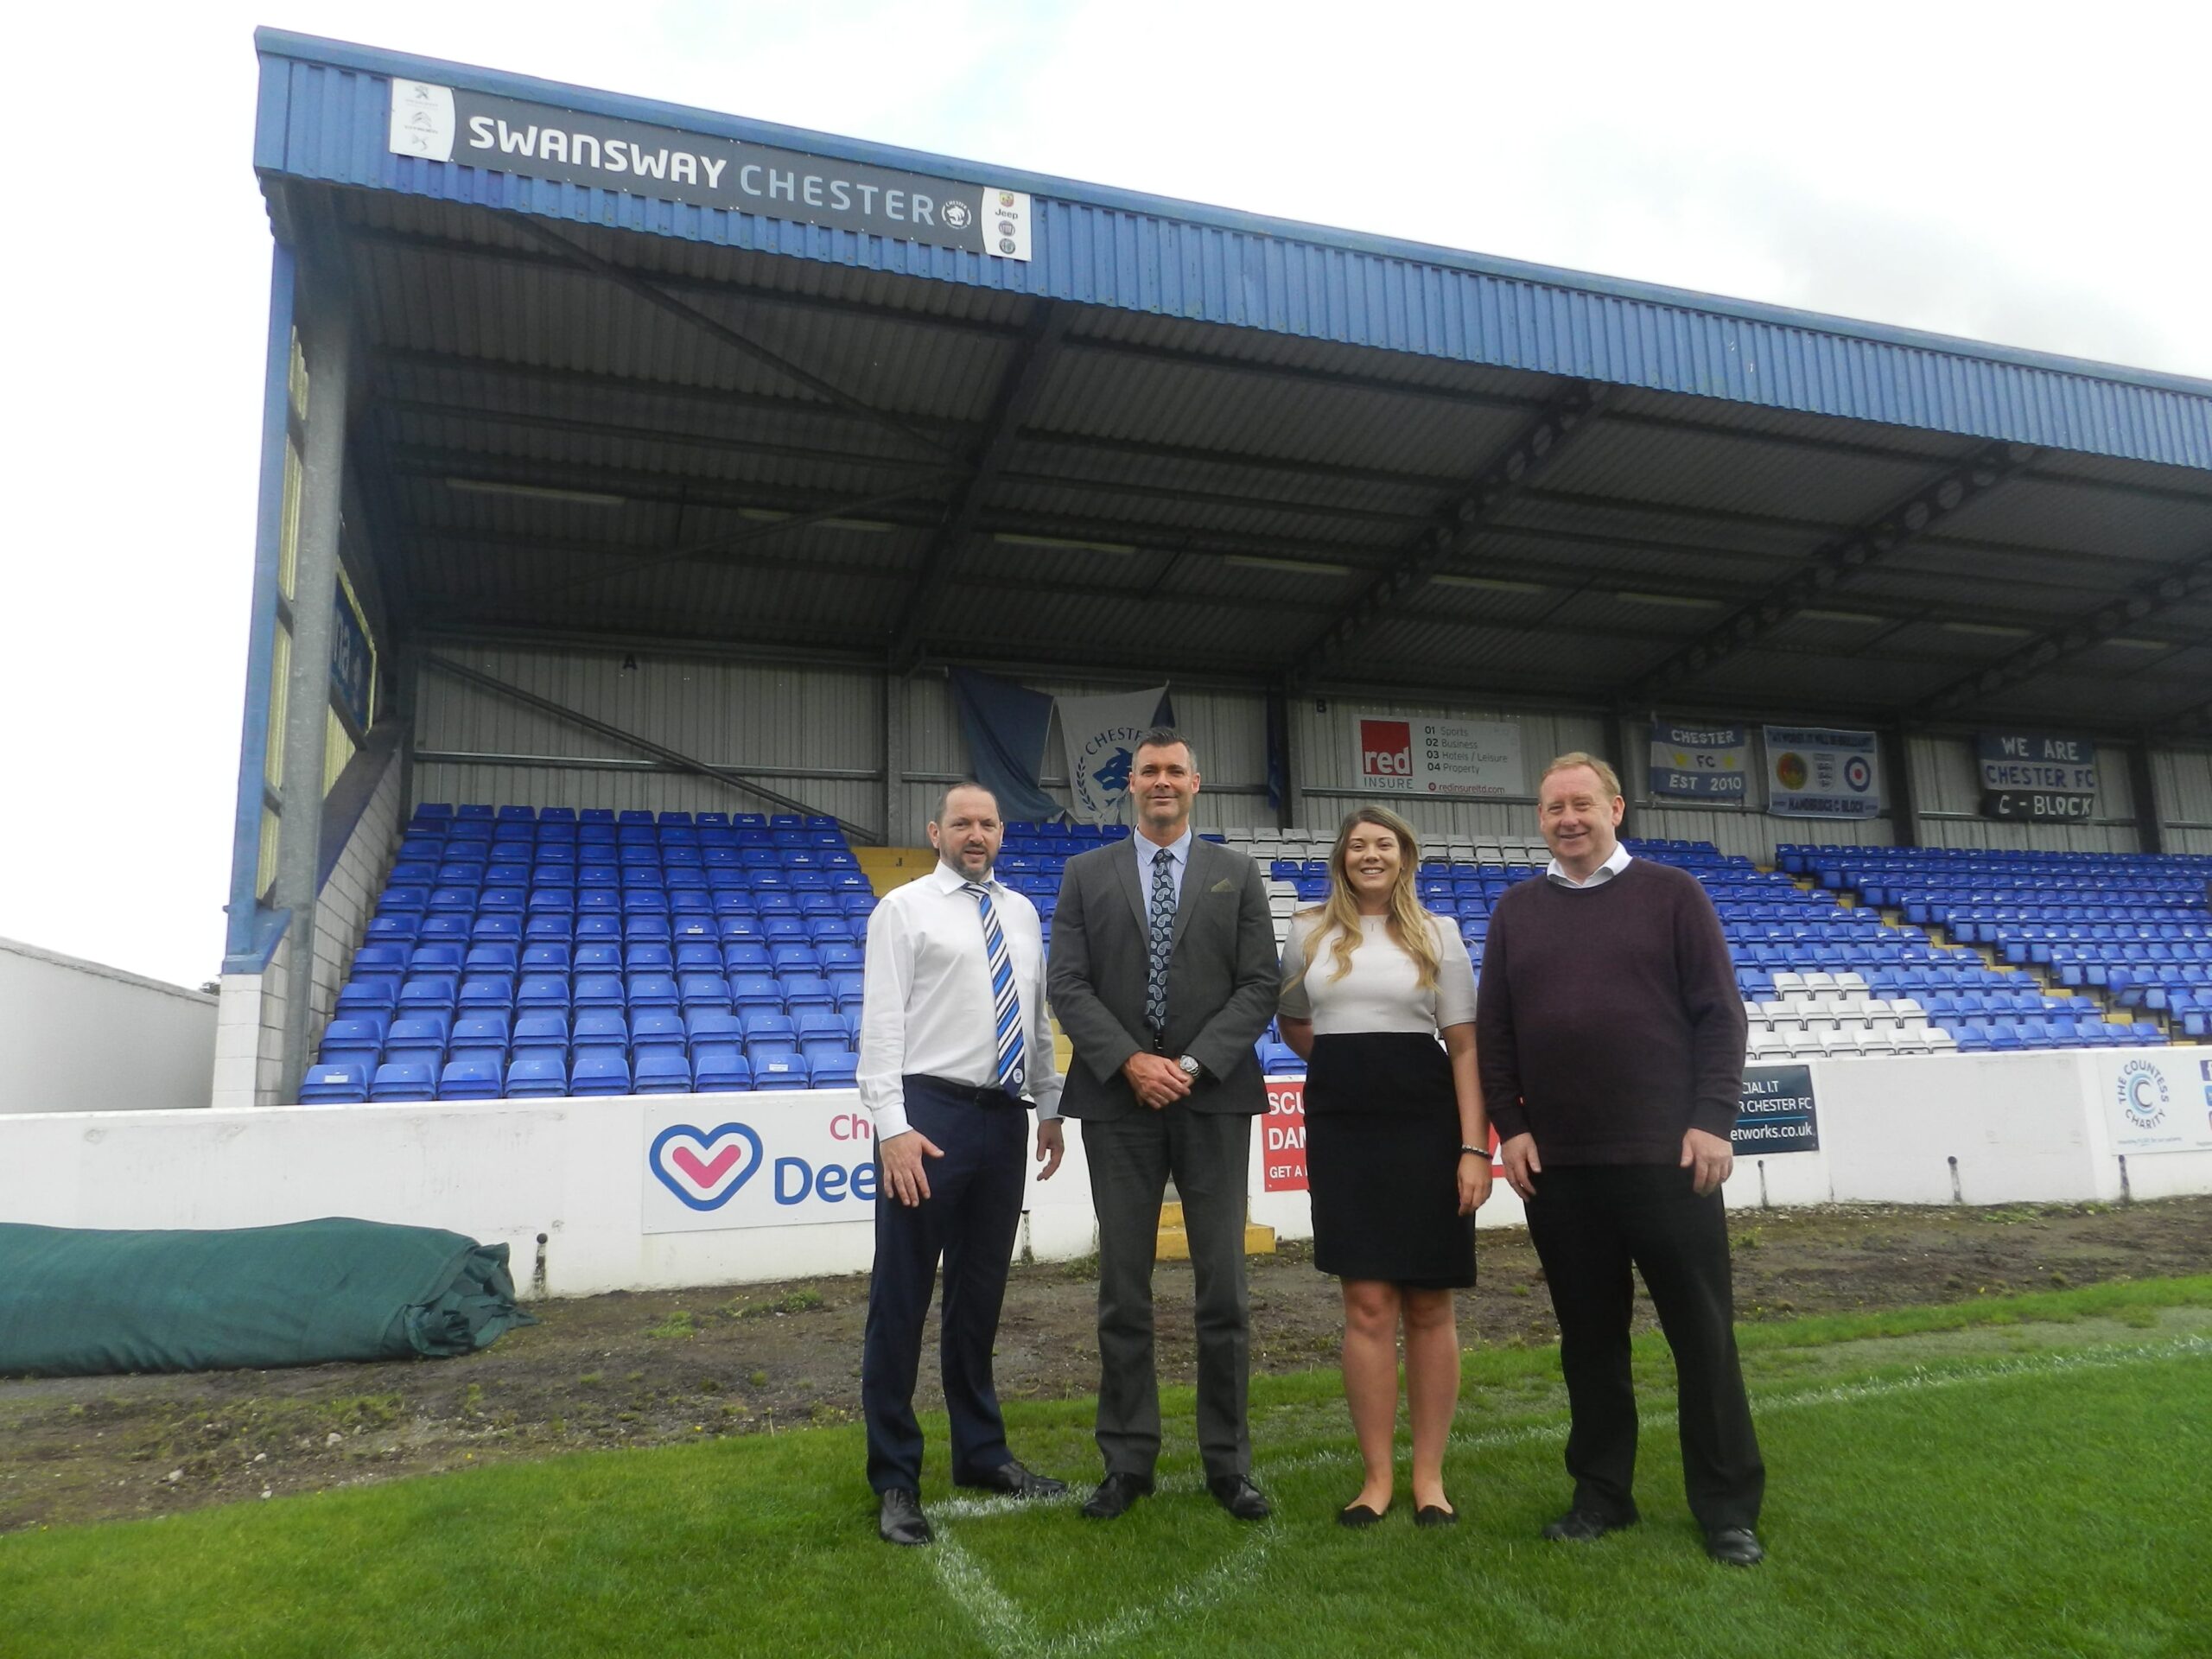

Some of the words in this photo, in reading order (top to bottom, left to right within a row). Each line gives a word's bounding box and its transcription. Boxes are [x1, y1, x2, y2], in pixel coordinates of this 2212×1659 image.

[469, 116, 727, 188] SWANSWAY
[741, 164, 935, 226] CHESTER
[995, 208, 1019, 219] Jeep
[623, 654, 638, 670] A
[1425, 726, 1435, 734] 01
[1440, 726, 1468, 736] Sports
[1671, 730, 1735, 743] CHESTER
[1426, 738, 1439, 747] 02
[1442, 739, 1478, 749] Business
[2001, 736, 2030, 757] WE
[2044, 740, 2080, 760] ARE
[1364, 747, 1410, 774] red
[1427, 750, 1440, 759] 03
[1442, 752, 1469, 760] Hotels
[1478, 753, 1508, 763] Leisure
[1695, 754, 1715, 767] FC
[1427, 762, 1440, 771] 04
[1443, 763, 1480, 774] Property
[1363, 777, 1413, 789] INSURE
[1669, 773, 1698, 790] EST
[1710, 777, 1742, 791] 2010
[1986, 765, 2067, 788] CHESTER
[2075, 769, 2095, 787] FC
[1440, 783, 1505, 793] redinsureltd.com
[1999, 795, 2011, 814] C
[2033, 795, 2092, 816] BLOCK
[2117, 1077, 2127, 1104] THE
[2124, 1059, 2170, 1103] COUNTESS
[1746, 1097, 1796, 1113] CHESTER
[1797, 1096, 1813, 1109] FC
[2125, 1109, 2166, 1129] CHARITY
[1730, 1122, 1813, 1141] etworks.co.uk
[1269, 1165, 1292, 1179] GET
[1294, 1165, 1303, 1177] A
[774, 1156, 876, 1205] Dee
